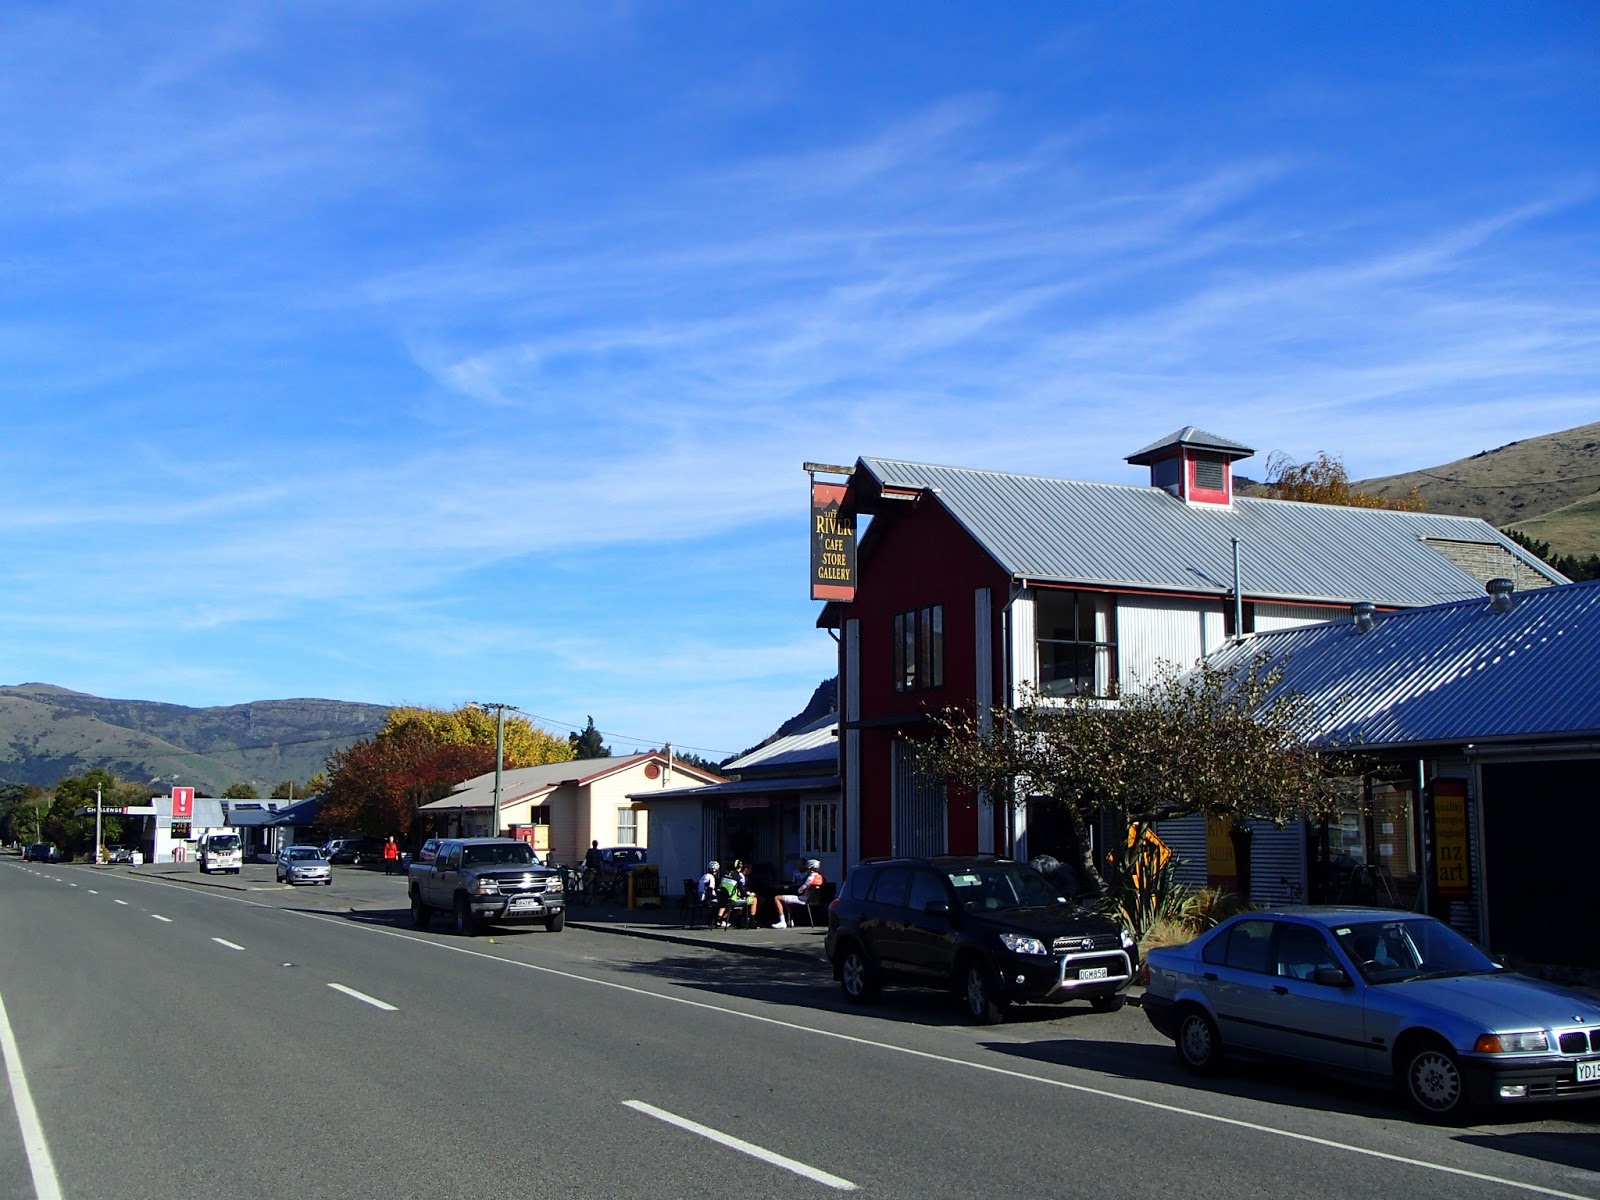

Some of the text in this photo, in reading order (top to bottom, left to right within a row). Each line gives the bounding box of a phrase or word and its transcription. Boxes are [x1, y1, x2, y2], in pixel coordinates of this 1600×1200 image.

[816, 515, 853, 536] RIVER
[825, 538, 844, 551] CAFE
[823, 553, 847, 566] STORE
[818, 566, 851, 581] GALLERY
[1440, 846, 1463, 861] nz
[1440, 862, 1465, 881] art
